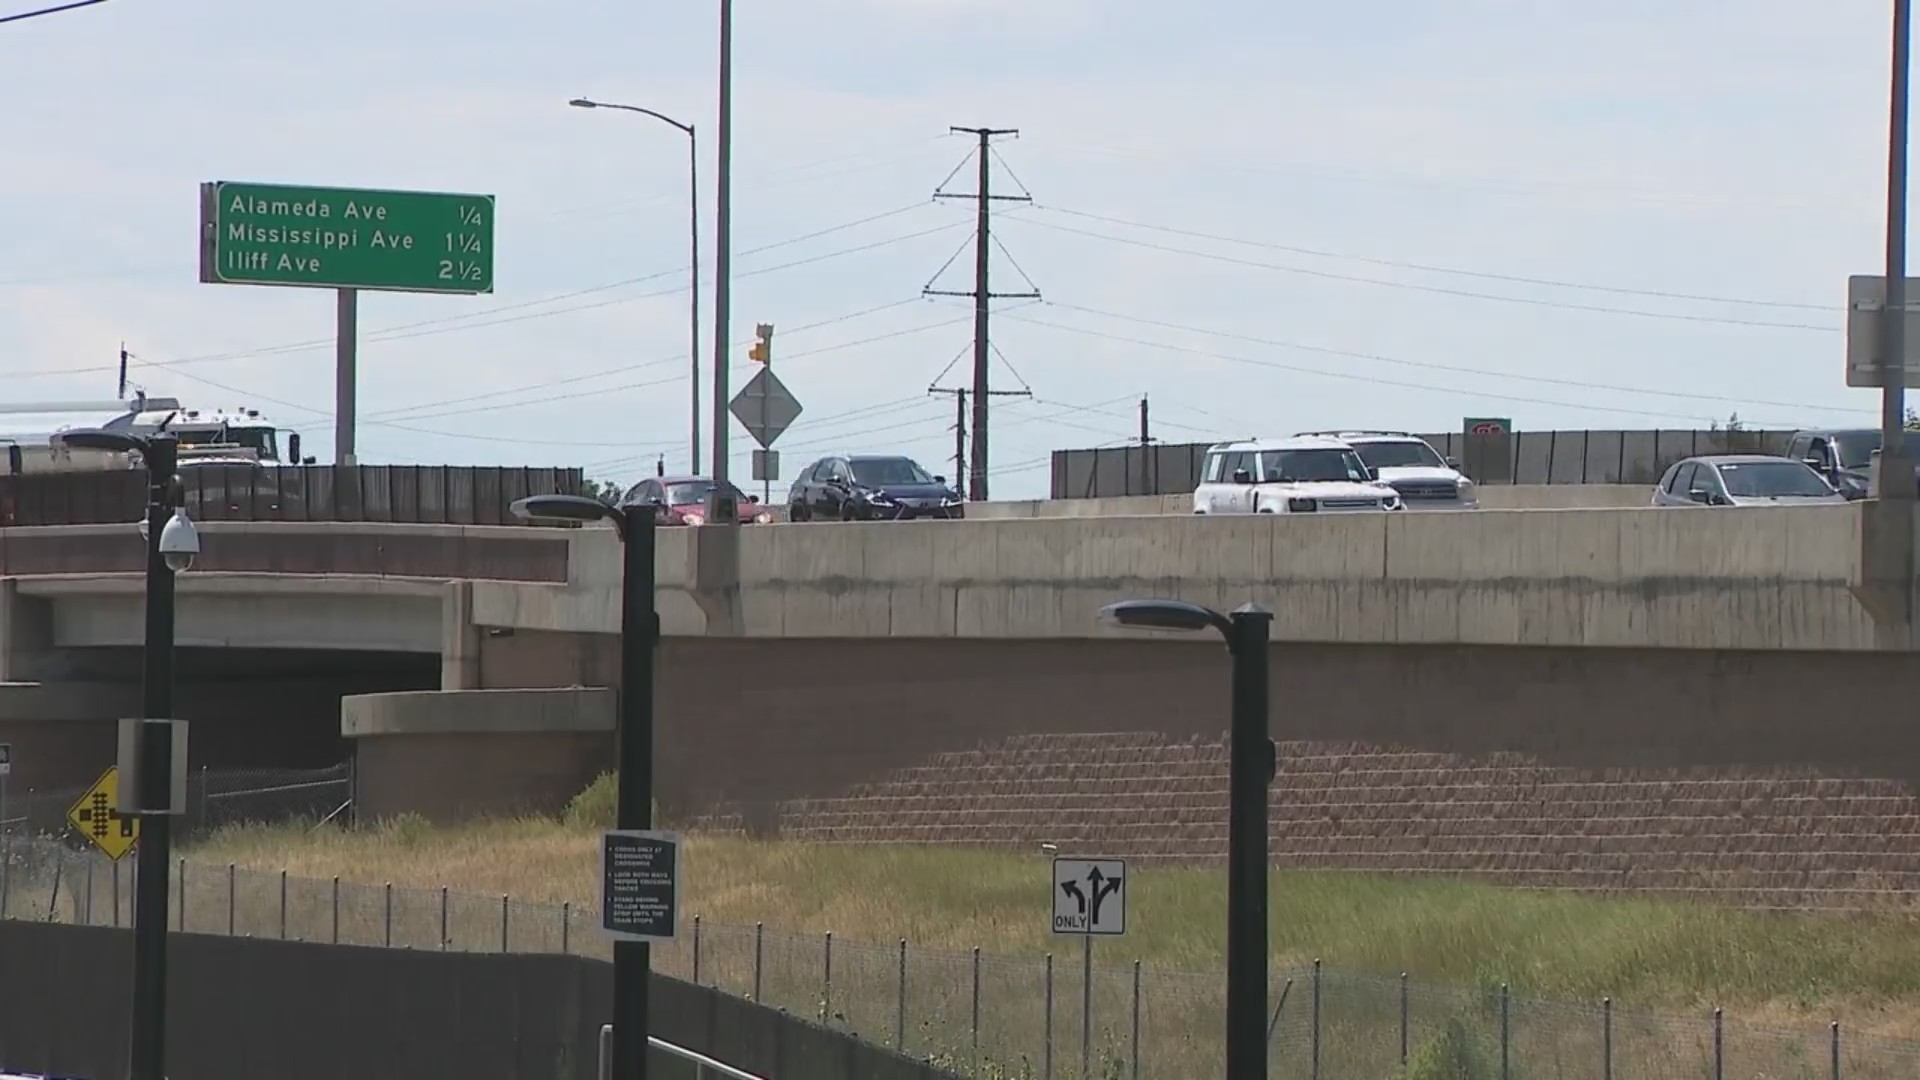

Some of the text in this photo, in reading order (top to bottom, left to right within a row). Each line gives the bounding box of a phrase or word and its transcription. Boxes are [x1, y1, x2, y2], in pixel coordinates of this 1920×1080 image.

[230, 195, 330, 217] Alameda
[344, 201, 387, 220] Ave
[228, 223, 357, 250] Mississippi
[371, 230, 413, 249] Ave
[228, 250, 268, 270] Iliff
[277, 253, 320, 272] Ave
[1055, 915, 1087, 928] ONLY
